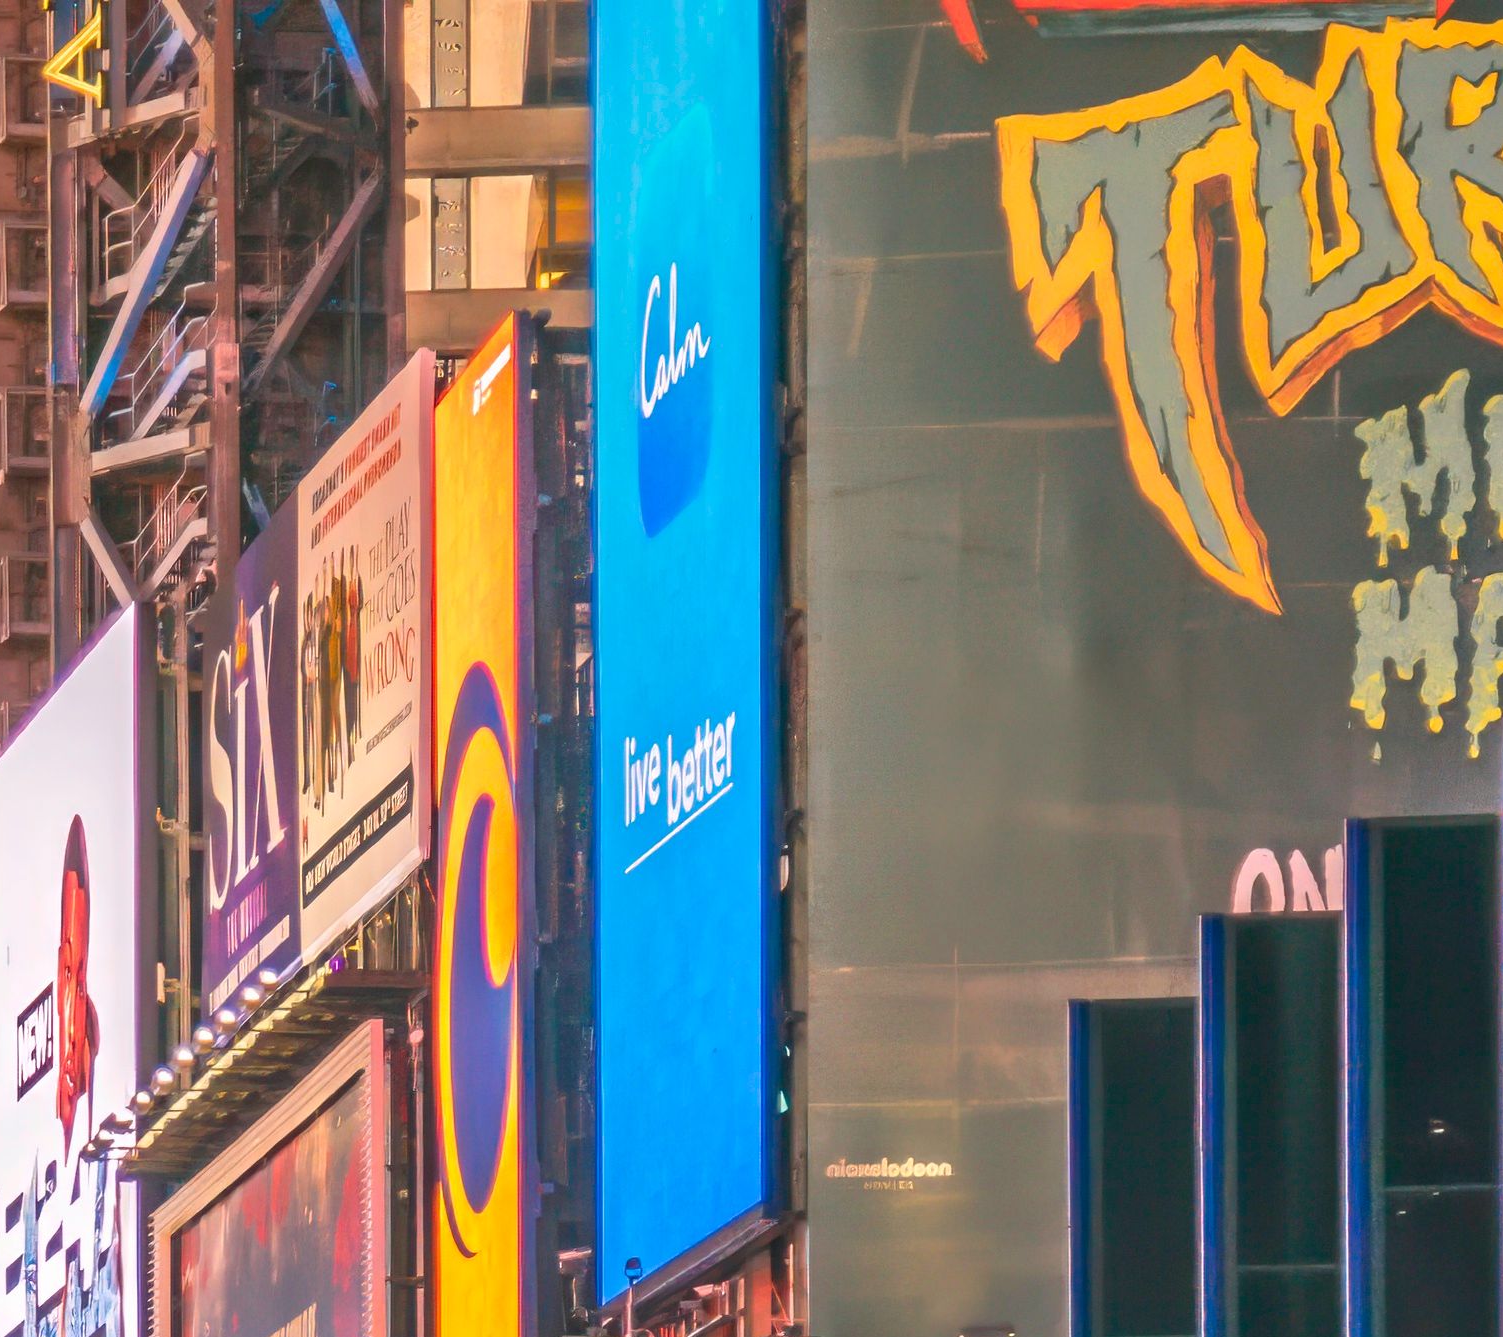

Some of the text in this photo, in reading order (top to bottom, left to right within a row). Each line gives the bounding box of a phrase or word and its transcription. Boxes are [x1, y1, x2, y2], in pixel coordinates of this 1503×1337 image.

[640, 261, 711, 419] Calm
[368, 496, 411, 580] THE PLAY
[385, 550, 416, 626] GOES
[365, 618, 416, 700] WRONG
[624, 710, 737, 827] live better
[19, 996, 53, 1090] NEW!
